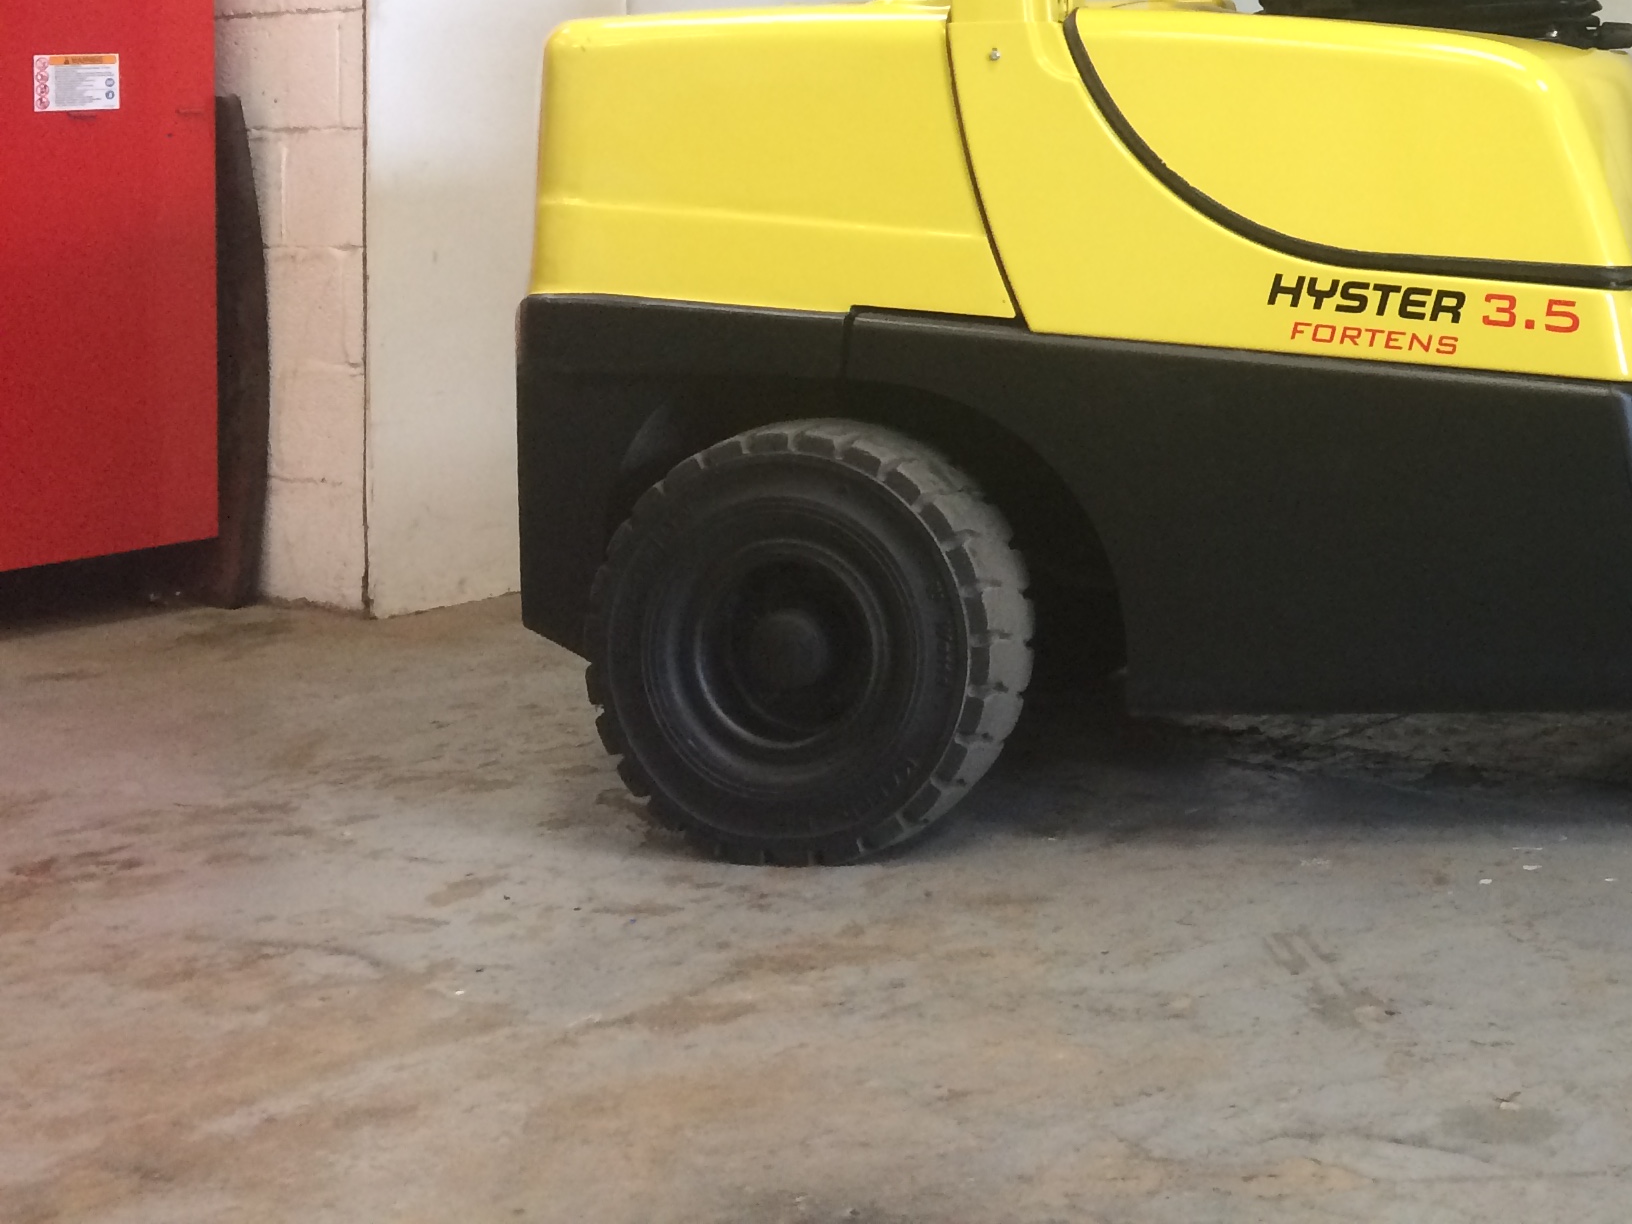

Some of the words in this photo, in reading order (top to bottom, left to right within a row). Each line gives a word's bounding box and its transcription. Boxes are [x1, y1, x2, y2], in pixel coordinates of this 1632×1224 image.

[1267, 273, 1466, 323] HYSTER
[1482, 293, 1580, 333] 3.5
[1290, 321, 1459, 355] FORTENS
